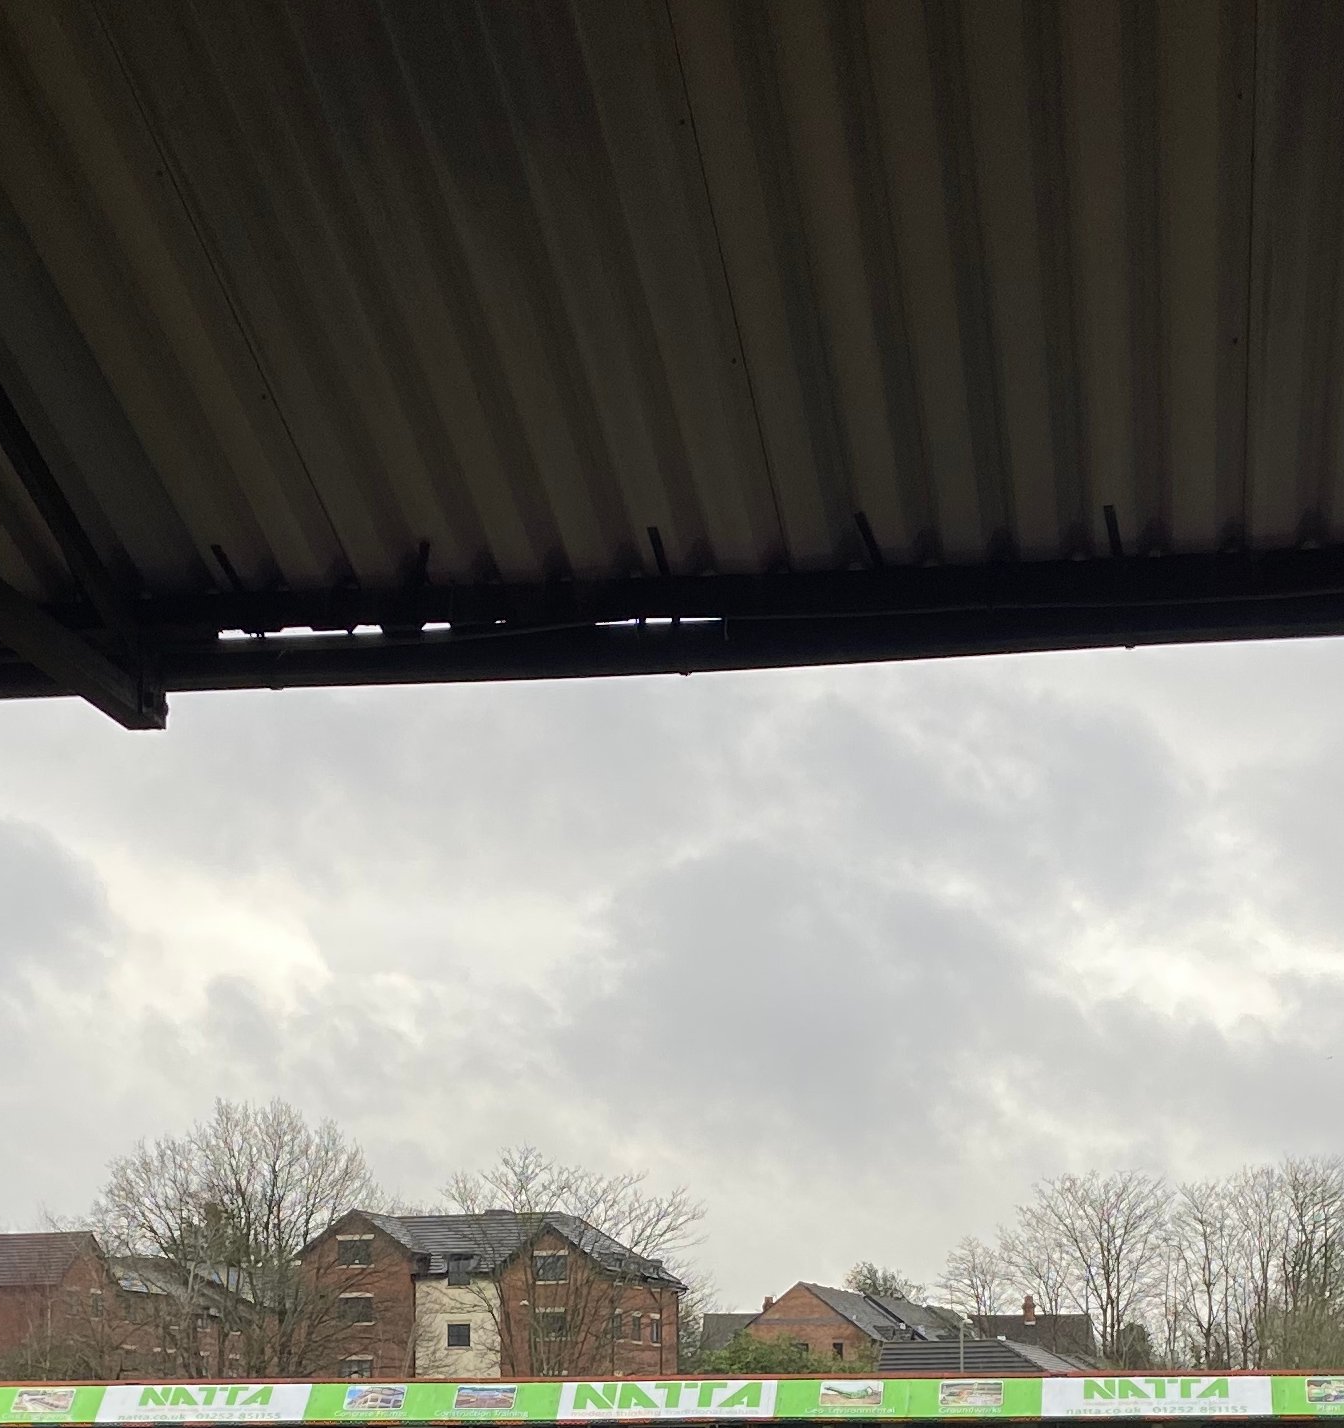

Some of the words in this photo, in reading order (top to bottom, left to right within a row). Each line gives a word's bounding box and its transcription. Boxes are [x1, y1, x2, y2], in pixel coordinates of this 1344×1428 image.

[138, 1386, 273, 1407] NATTA
[571, 1382, 764, 1409] NATTA
[1083, 1378, 1229, 1400] NATTA
[196, 1412, 233, 1420] 01252
